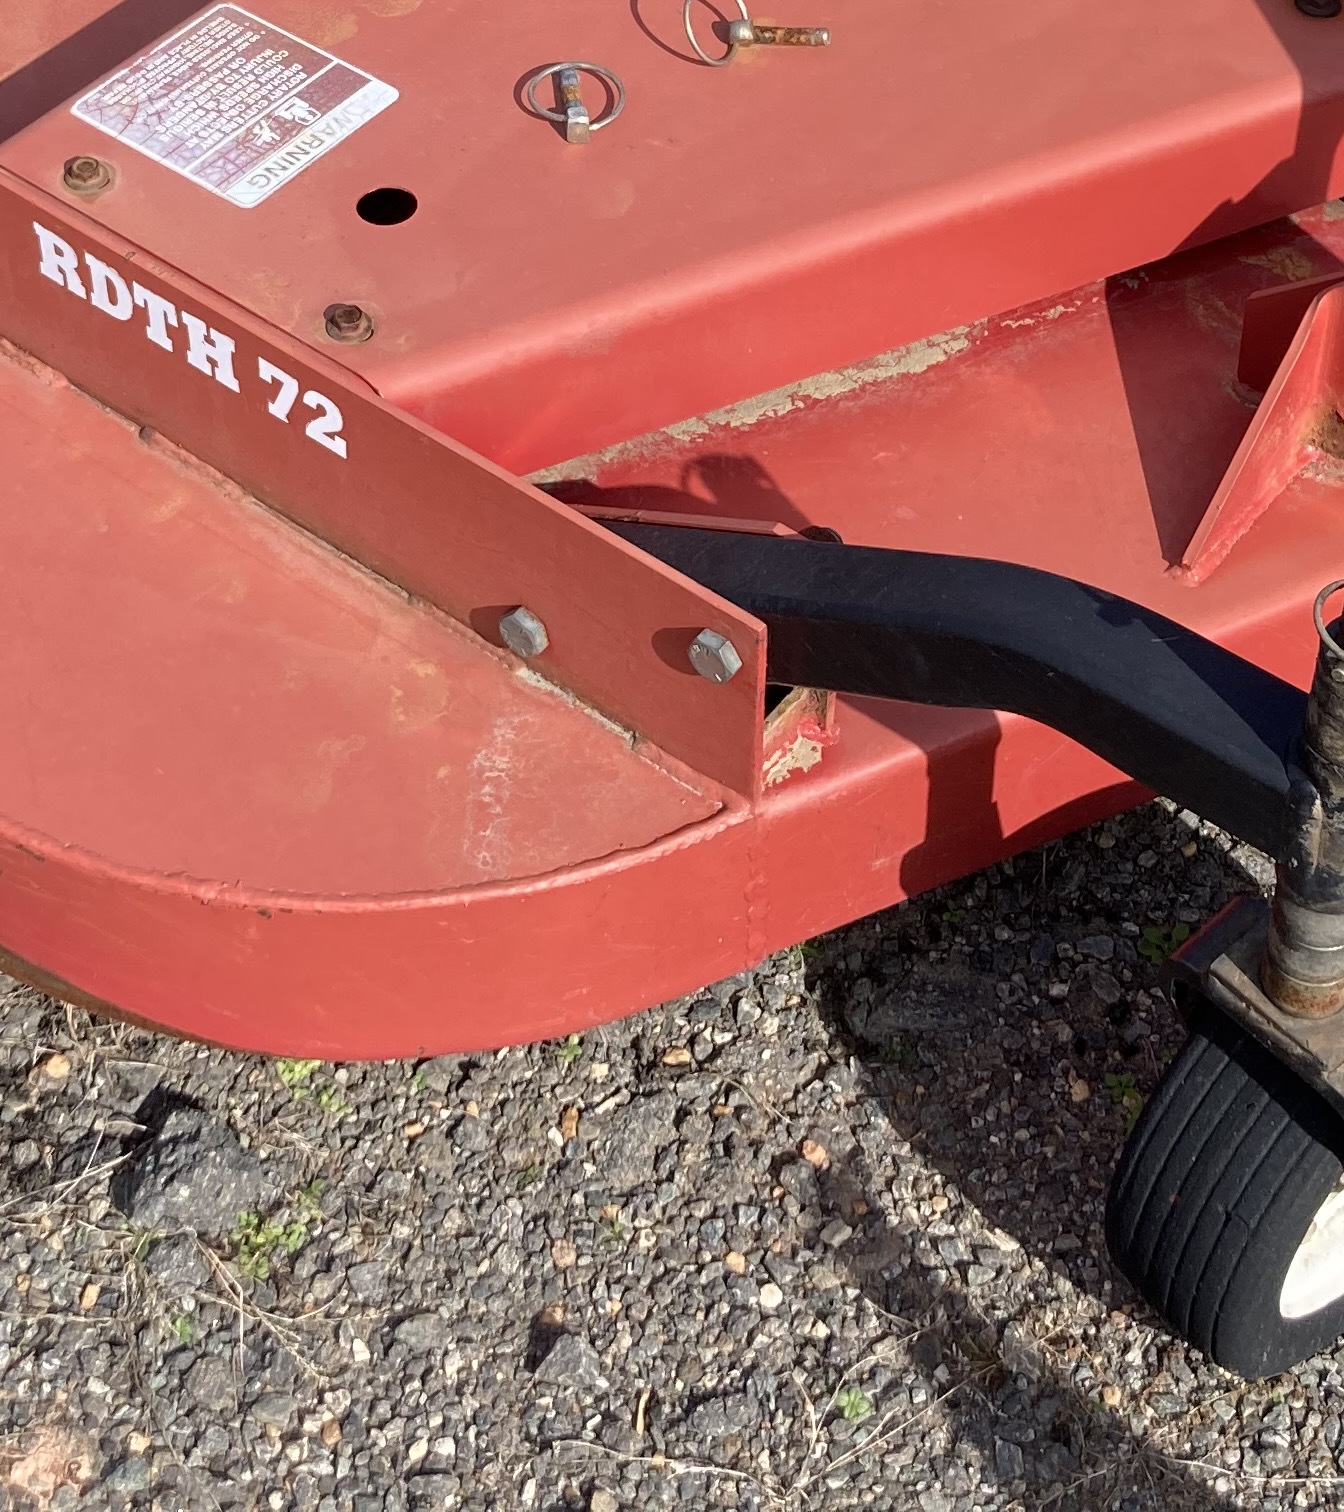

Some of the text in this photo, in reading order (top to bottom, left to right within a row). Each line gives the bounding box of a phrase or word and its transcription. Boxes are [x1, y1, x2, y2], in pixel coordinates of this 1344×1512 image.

[226, 56, 247, 70] OR
[236, 47, 275, 74] INJURY
[251, 48, 291, 76] COULD
[256, 63, 286, 84] HIGH
[213, 72, 256, 102] RESULT
[222, 71, 242, 84] TO
[242, 62, 303, 105] DISCHARGE
[157, 107, 207, 142] SERIOUS
[180, 110, 220, 137] WHICH
[195, 102, 247, 139] OBJECTS
[197, 71, 308, 150] ROTARY CUTTERS MAY
[244, 111, 355, 191] WARNING
[33, 220, 347, 459] RDTH 72
